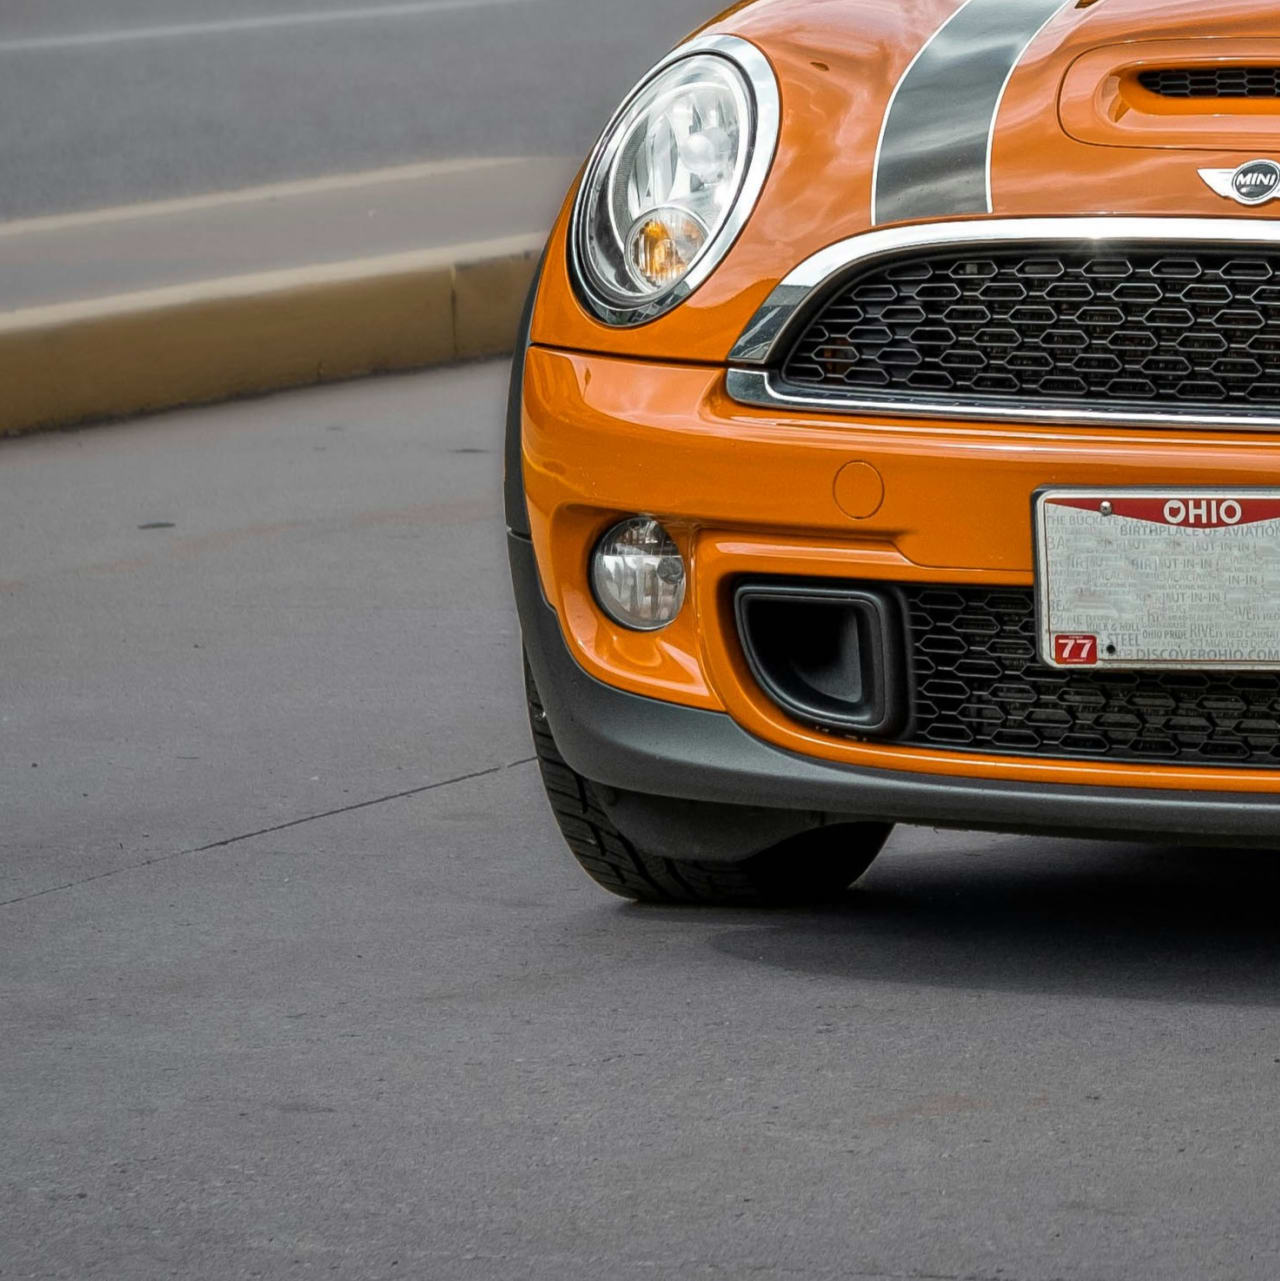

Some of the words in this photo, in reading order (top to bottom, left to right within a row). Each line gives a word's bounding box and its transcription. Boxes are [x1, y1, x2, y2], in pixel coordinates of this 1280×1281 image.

[1236, 172, 1276, 186] MINI
[1163, 499, 1242, 524] OHIO
[1120, 523, 1200, 537] BIRTHPLACE
[1203, 525, 1222, 537] OF
[1107, 632, 1140, 647] STEEL
[1058, 639, 1093, 658] 77
